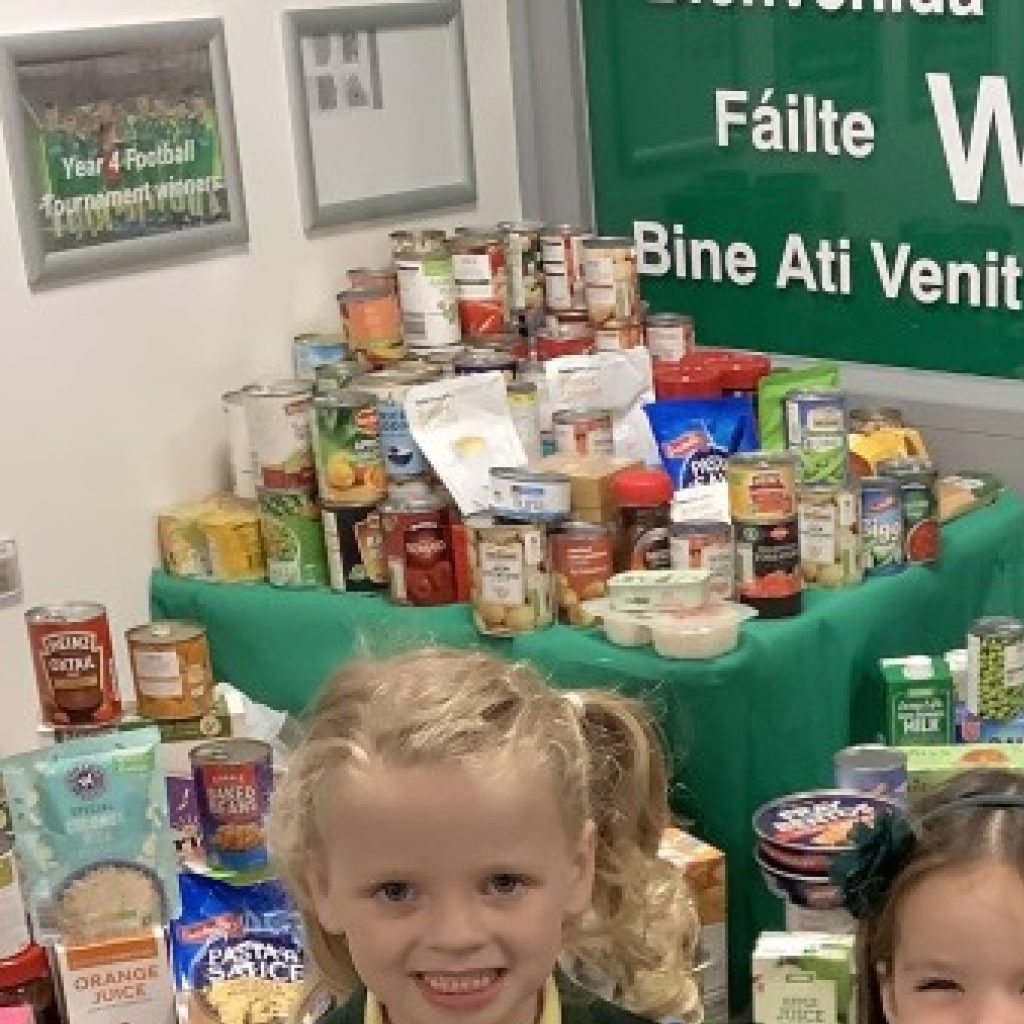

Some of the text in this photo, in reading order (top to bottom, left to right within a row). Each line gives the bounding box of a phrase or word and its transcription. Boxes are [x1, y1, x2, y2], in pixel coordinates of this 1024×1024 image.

[715, 88, 876, 158] Fáilte
[62, 139, 195, 179] Year 4 Football
[632, 220, 1023, 311] Bine Ati Venit
[74, 965, 159, 991] ORANGE
[91, 982, 147, 1005] JUICE
